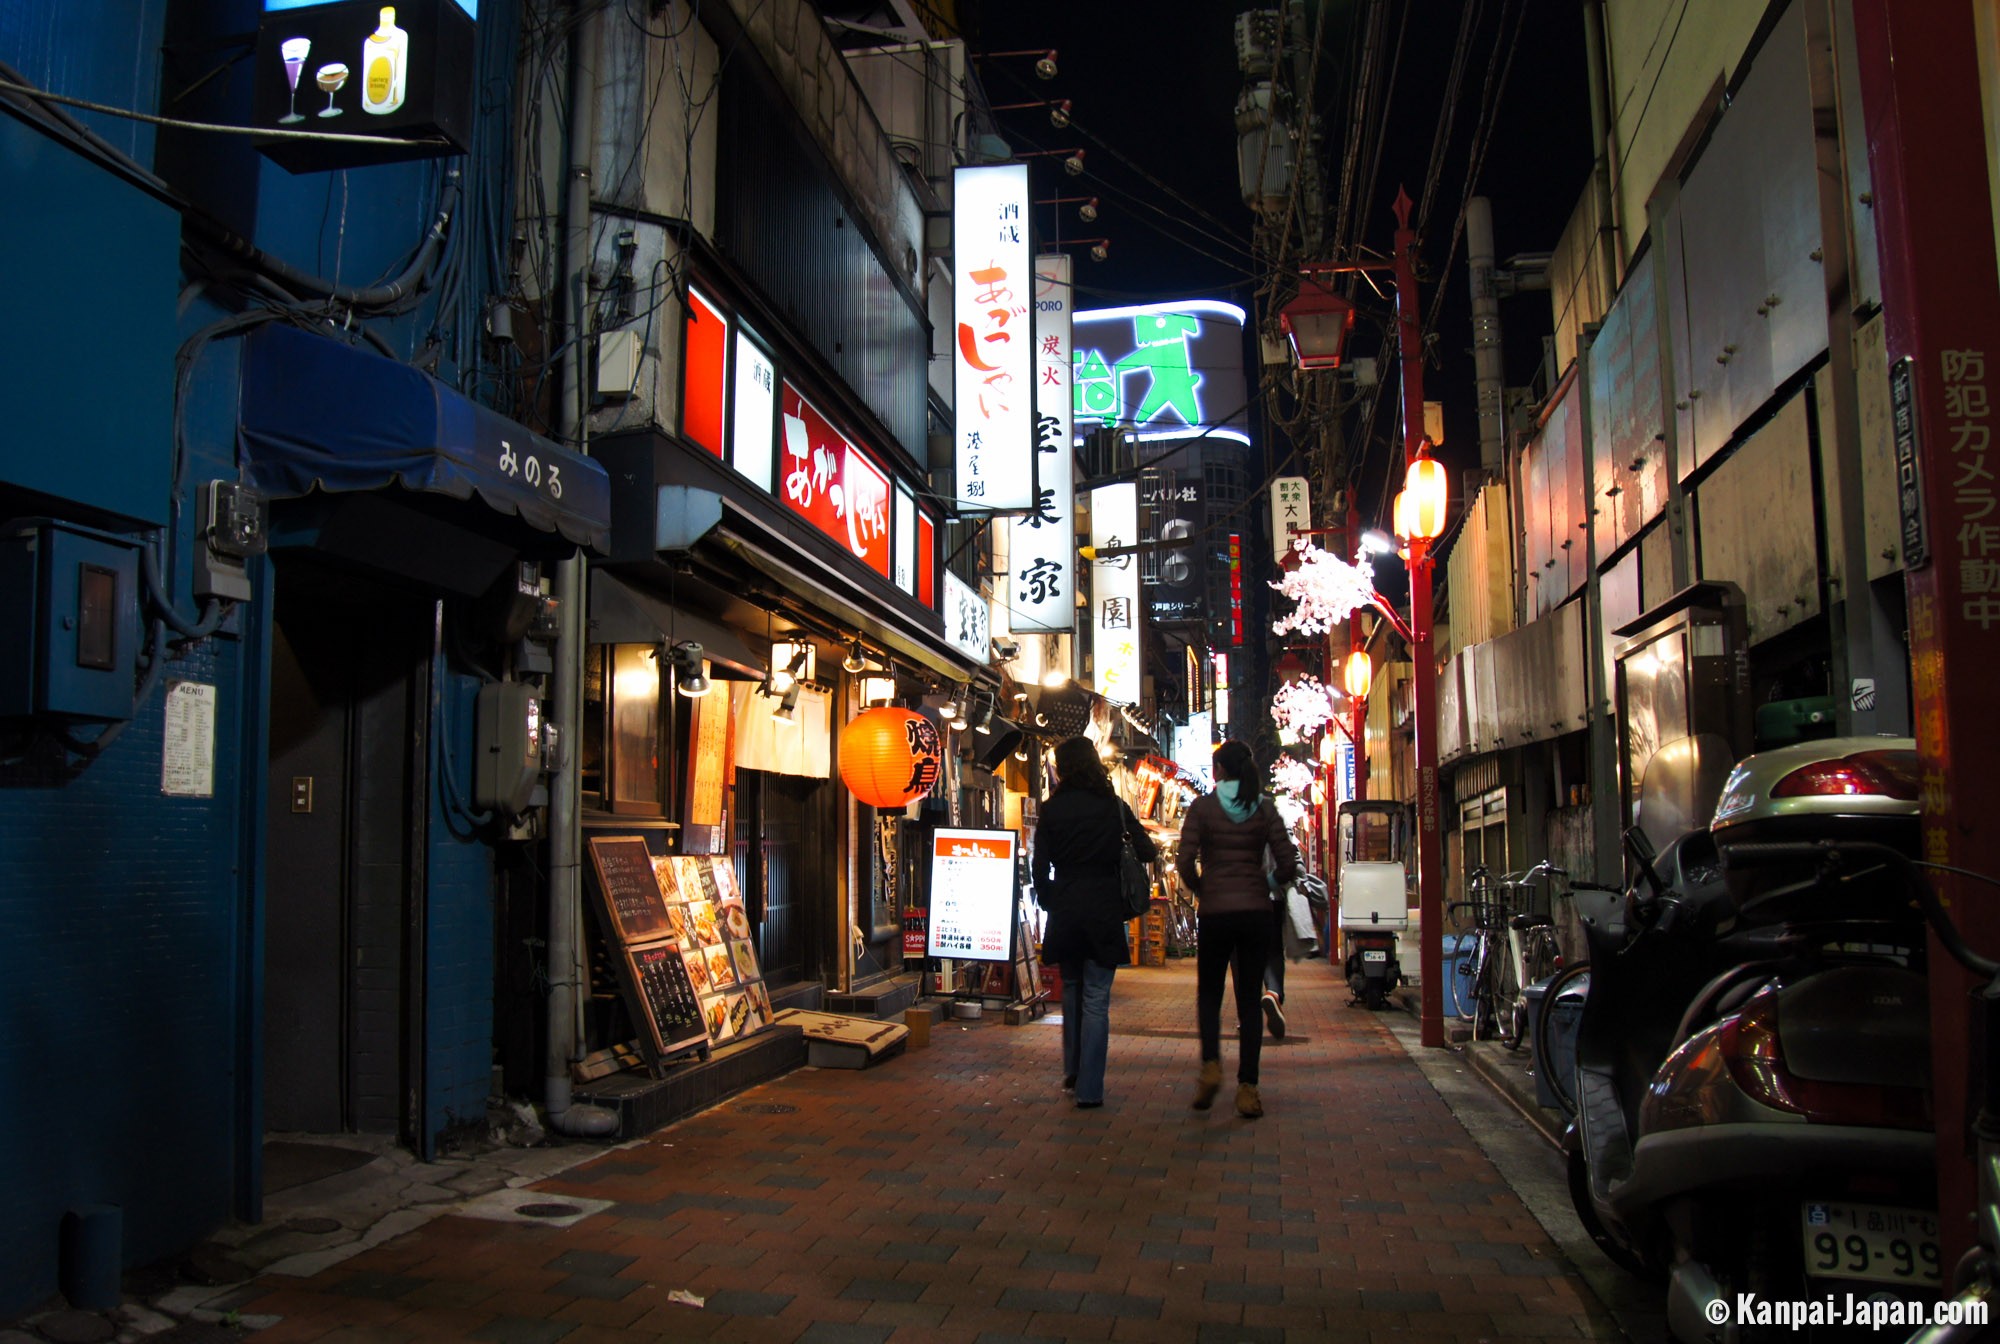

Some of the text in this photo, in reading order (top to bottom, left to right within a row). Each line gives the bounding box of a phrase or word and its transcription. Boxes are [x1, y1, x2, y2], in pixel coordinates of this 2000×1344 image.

[1042, 334, 1062, 386] 炭火
[499, 440, 562, 499] みのる
[1940, 349, 2000, 631] 防犯カメラ作動中
[180, 685, 205, 697] MENU
[903, 718, 940, 794] 焼鳥
[1814, 1232, 1943, 1280] 99-99
